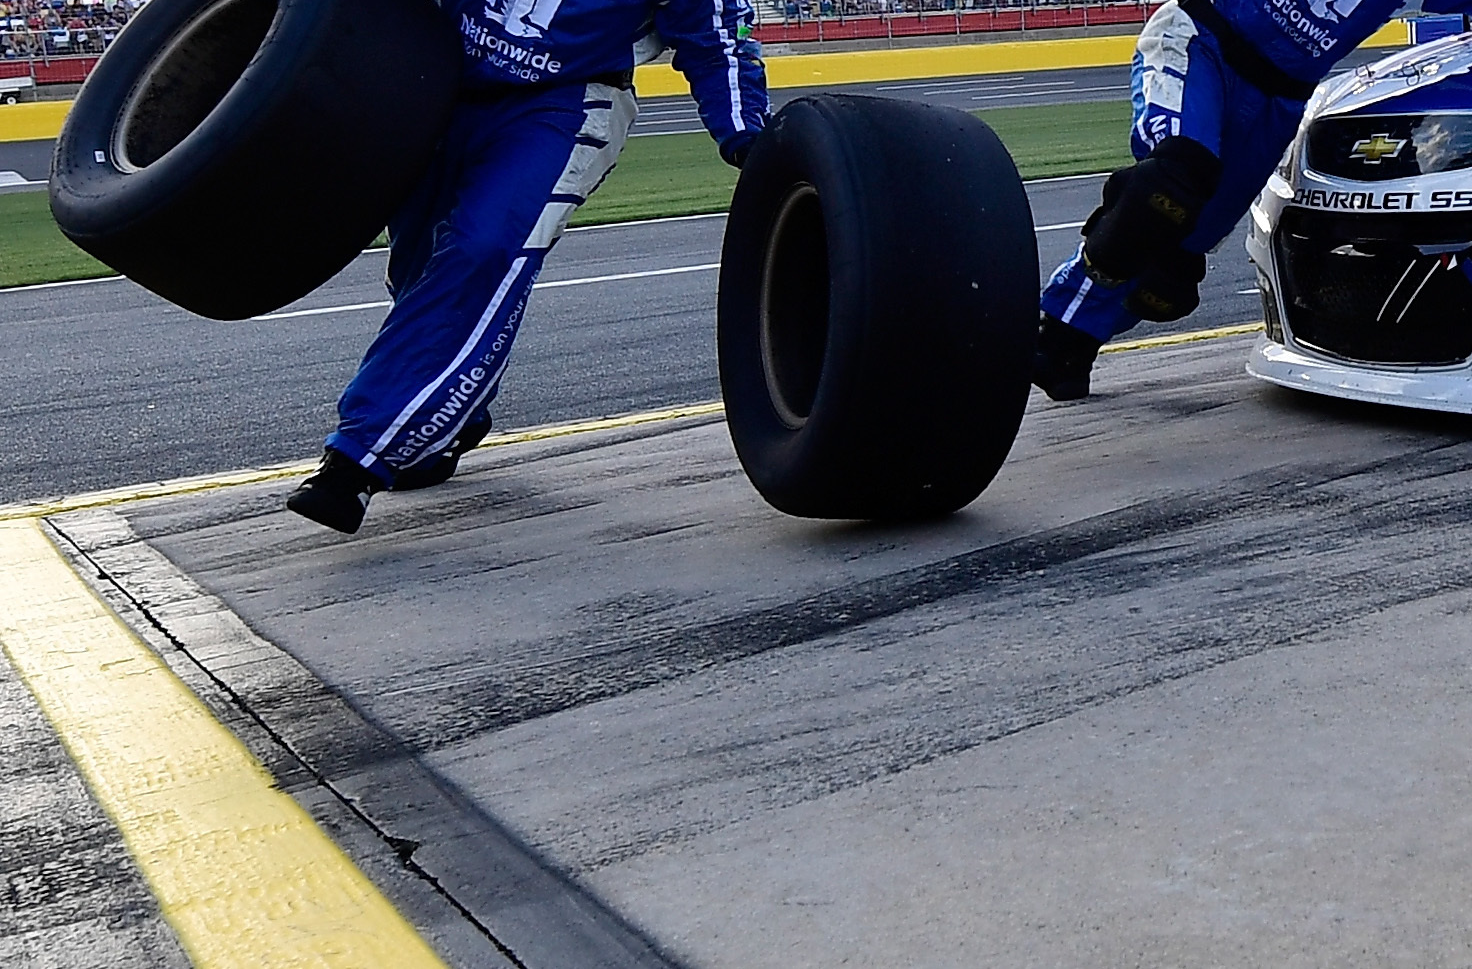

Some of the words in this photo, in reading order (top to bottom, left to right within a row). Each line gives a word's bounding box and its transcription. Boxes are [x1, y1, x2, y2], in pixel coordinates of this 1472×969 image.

[508, 64, 540, 83] side
[1291, 188, 1421, 210] CHEVROLET
[384, 366, 486, 467] Nationwide
[479, 352, 495, 366] is
[492, 333, 508, 352] on
[504, 300, 524, 332] your
